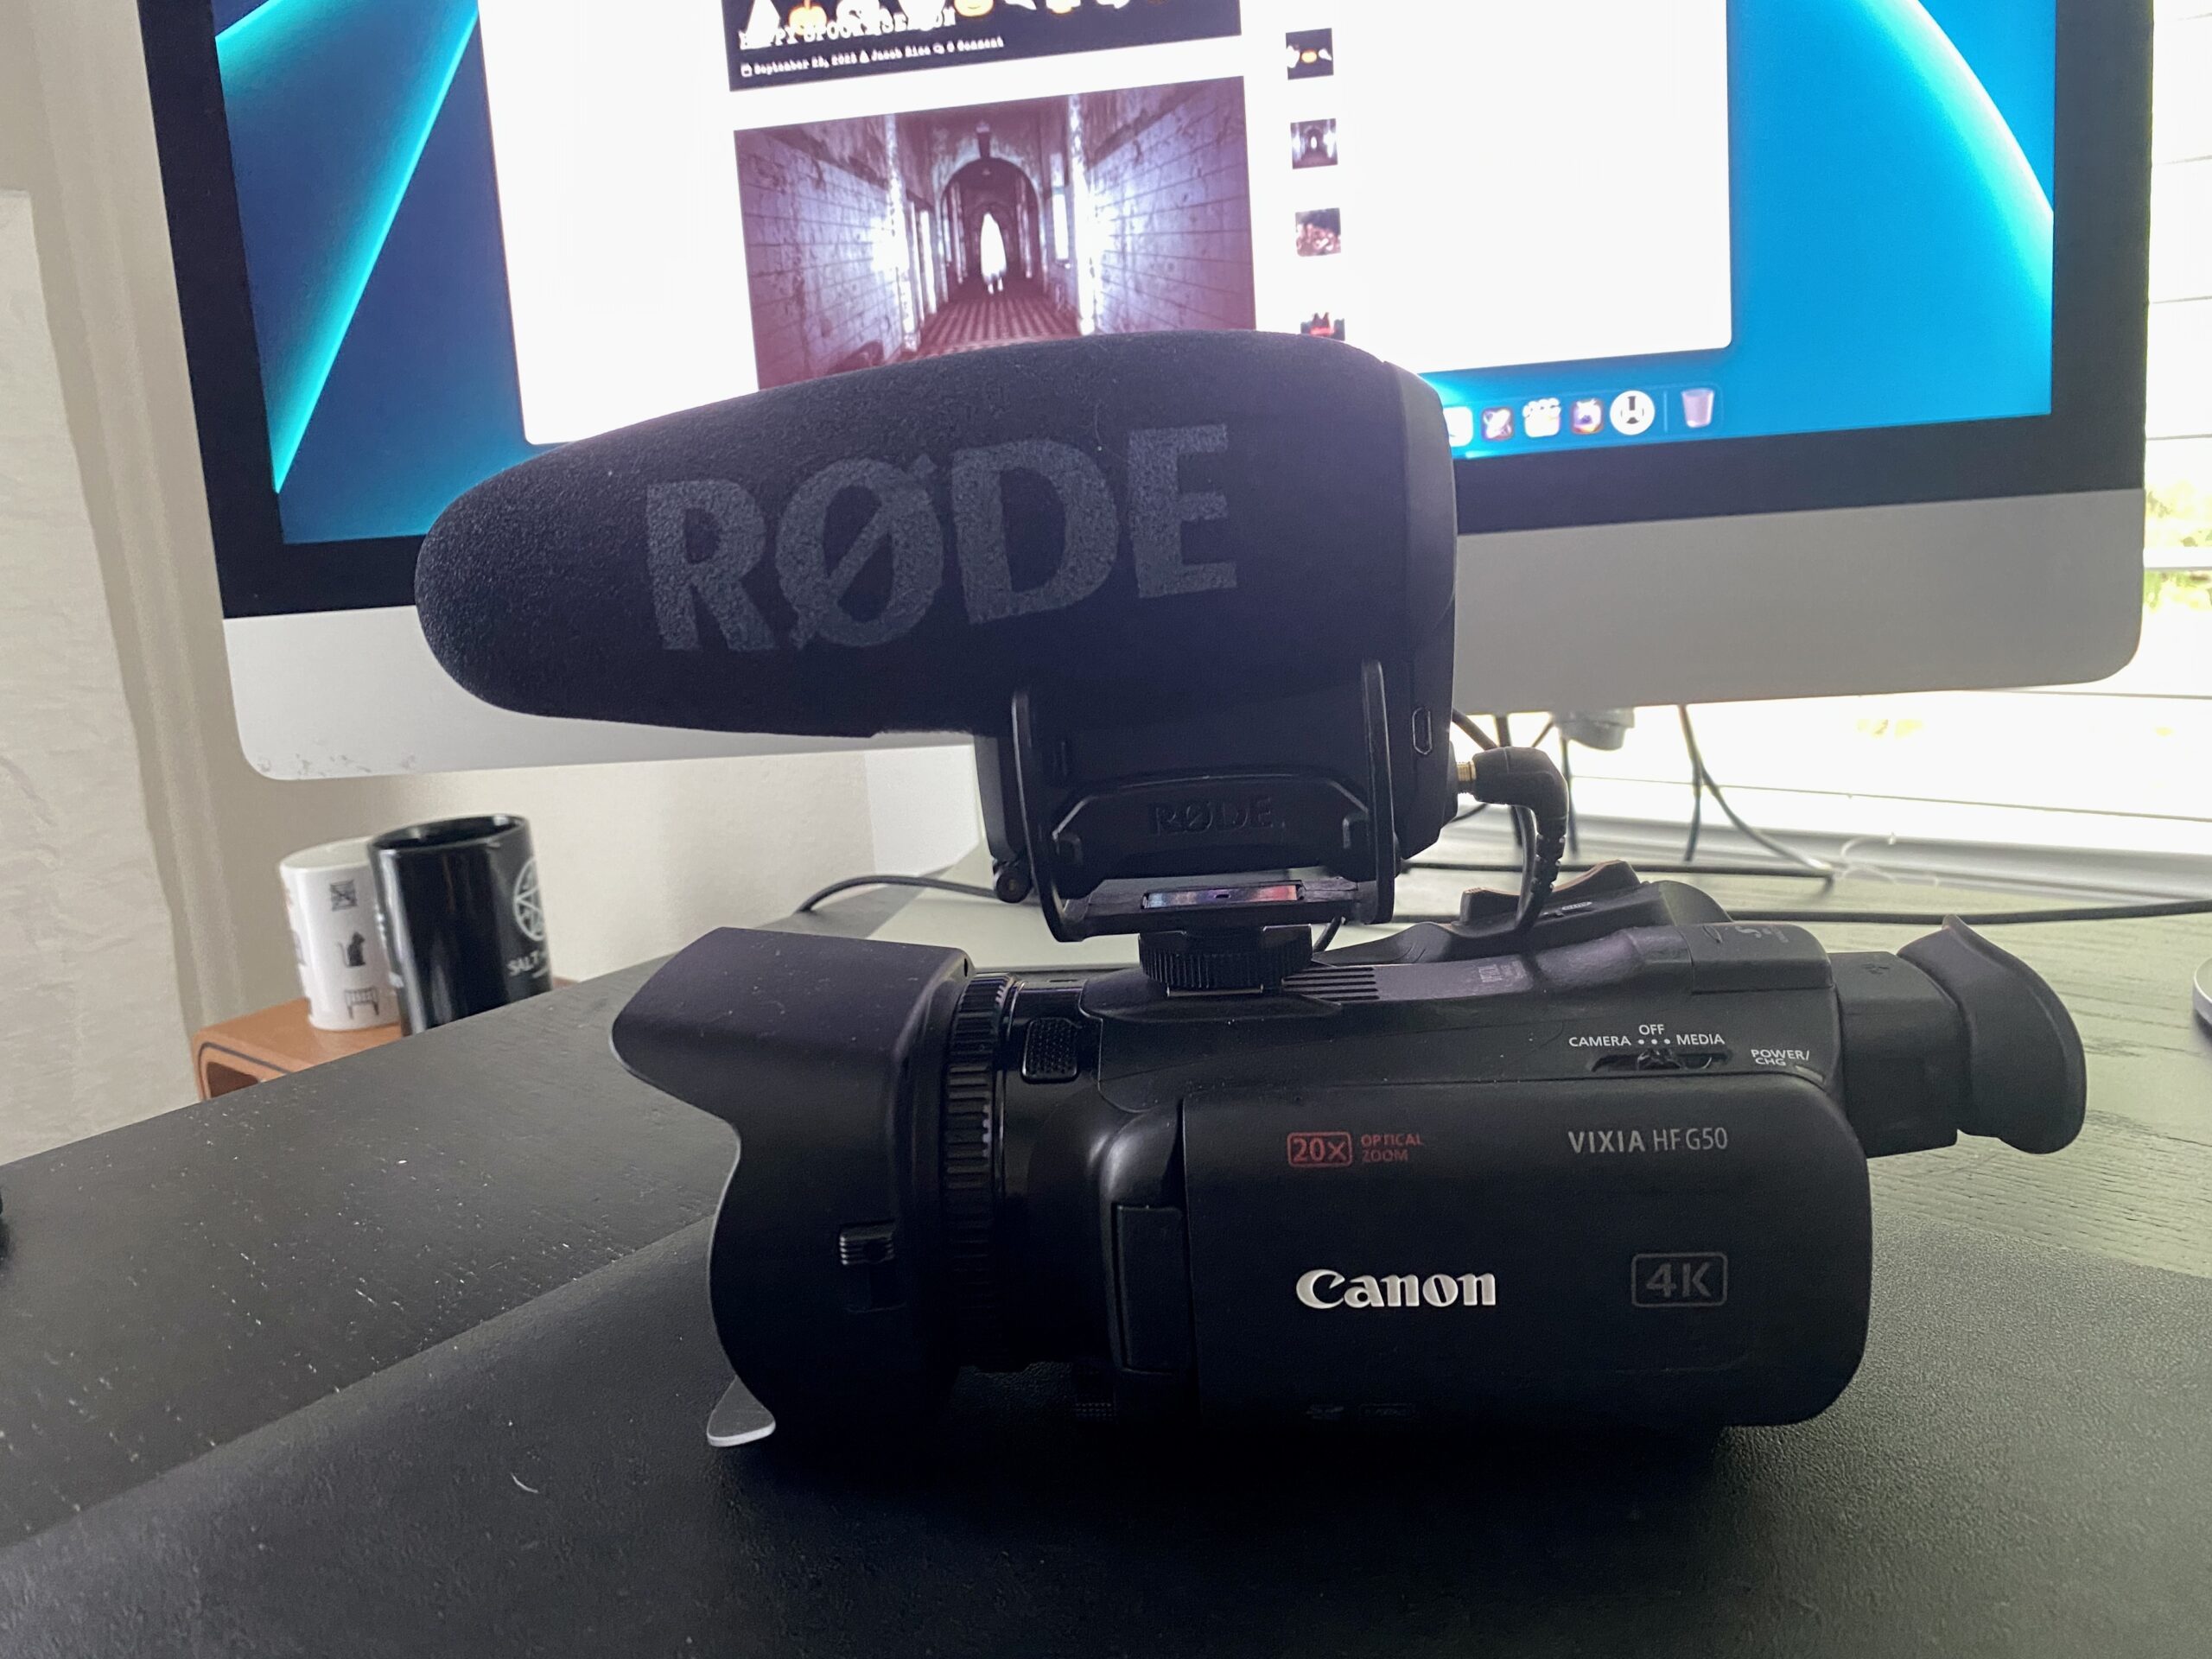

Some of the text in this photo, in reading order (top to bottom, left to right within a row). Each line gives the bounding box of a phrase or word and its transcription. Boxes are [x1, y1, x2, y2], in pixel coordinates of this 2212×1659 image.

[646, 423, 1237, 652] RØDE
[1638, 1024, 1665, 1036] OFF
[1568, 1033, 1726, 1047] CAMERA MEDIA
[1751, 1049, 1810, 1062] POWER/
[1755, 1057, 1787, 1066] CHG
[1360, 1133, 1423, 1147] OPTICAL
[1567, 1127, 1728, 1154] VIXIA HF G50
[1361, 1148, 1408, 1162] ZOOM
[1645, 1262, 1712, 1298] 4K
[1295, 1269, 1497, 1309] Canon
